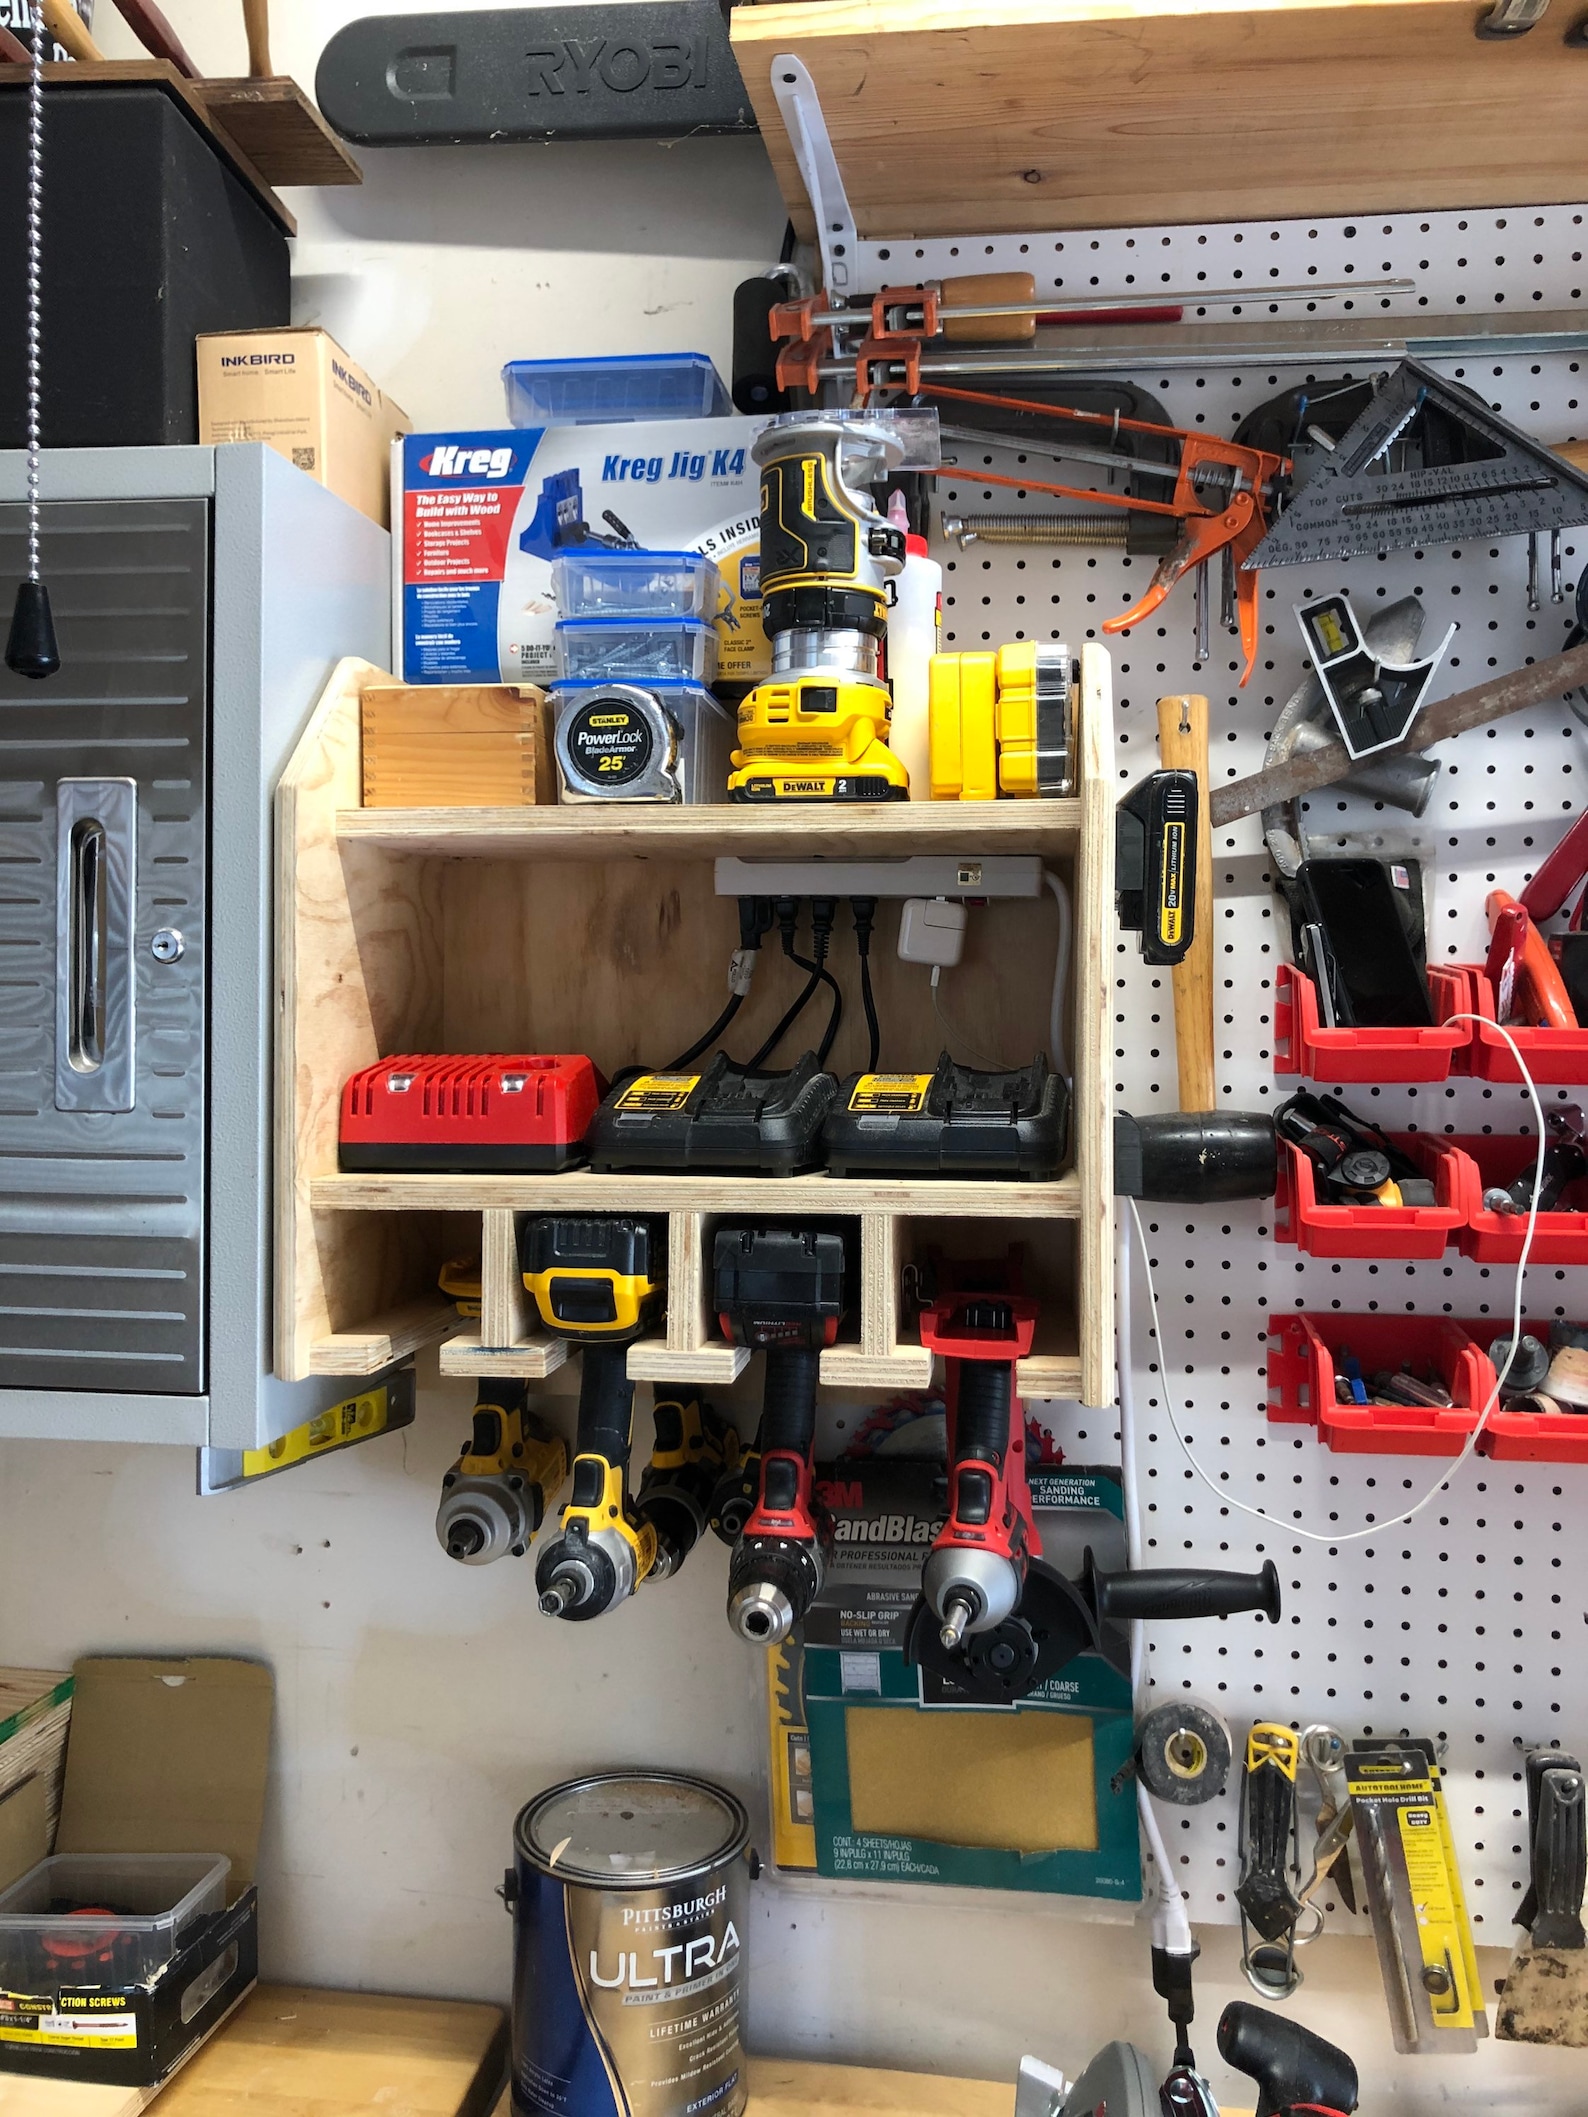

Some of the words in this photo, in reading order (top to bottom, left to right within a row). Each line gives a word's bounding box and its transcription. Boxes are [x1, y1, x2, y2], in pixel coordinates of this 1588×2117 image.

[524, 36, 709, 96] RYOBI
[221, 354, 295, 367] INKBIRD
[332, 359, 372, 406] INKBIRD
[429, 446, 512, 478] Kreg
[602, 455, 663, 483] Kreg
[668, 451, 705, 480] Jig
[711, 449, 745, 476] K4
[1391, 483, 1404, 491] 24
[1491, 469, 1497, 477] 5
[1524, 465, 1530, 473] 2
[1410, 468, 1454, 479] HIP-VAL
[416, 496, 435, 505] The
[437, 494, 461, 505] Easy
[463, 493, 485, 503] Way
[487, 493, 498, 502] to
[1310, 497, 1328, 507] TOP
[1336, 493, 1363, 504] CUTS
[416, 507, 444, 517] Build
[445, 505, 468, 516] with
[470, 504, 500, 515] Wood
[1366, 521, 1378, 529] 24
[1420, 513, 1430, 521] 12
[1477, 506, 1482, 514] 6
[1521, 500, 1525, 508] 3
[1296, 520, 1338, 531] COMMON
[1318, 539, 1330, 547] 75
[1356, 533, 1368, 541] 65
[1372, 531, 1385, 539] 60
[1405, 526, 1418, 534] 50
[1422, 524, 1434, 532] 45
[1453, 520, 1465, 528] 35
[1469, 518, 1482, 526] 30
[1486, 515, 1499, 524] 25
[1505, 512, 1518, 521] 20
[1529, 510, 1539, 518] 15
[1581, 503, 1586, 511] 5
[727, 661, 751, 669] OFFER
[592, 716, 626, 724] STANLEY
[578, 729, 643, 745] PowerLock
[585, 745, 637, 755] BladeArmor
[839, 780, 847, 788] 2
[816, 1481, 863, 1508] 3M
[1040, 1486, 1085, 1495] SANDING
[1031, 1495, 1100, 1506] ERFORMANCE
[831, 1514, 943, 1542] andBlas
[840, 1550, 918, 1561] PROFESSIONAL
[866, 1592, 900, 1601] ABRASIVE
[840, 1610, 876, 1620] NO-SLIP
[877, 1611, 899, 1620] GRIP
[840, 1629, 852, 1637] USE
[853, 1629, 867, 1637] WET
[868, 1629, 877, 1637] OR
[878, 1629, 890, 1637] DRY
[1049, 1680, 1079, 1693] COARSE
[856, 1838, 861, 1846] 4
[863, 1838, 912, 1851] SHEETS/HOJAS
[834, 1848, 838, 1858] 9
[874, 1850, 881, 1859] 11
[853, 1861, 864, 1869] cm
[901, 1863, 940, 1876] EACH/CADA
[621, 1885, 727, 1926] PITTSBURGH
[590, 1921, 740, 1987] ULTRA
[625, 1993, 661, 2004] PAINT
[675, 1977, 713, 1996] PRIMER
[89, 1996, 126, 2007] SCREWS
[650, 2017, 698, 2038] LIFETIME
[686, 2087, 723, 2113] EXTERIOR
[724, 2073, 737, 2091] FLAT
